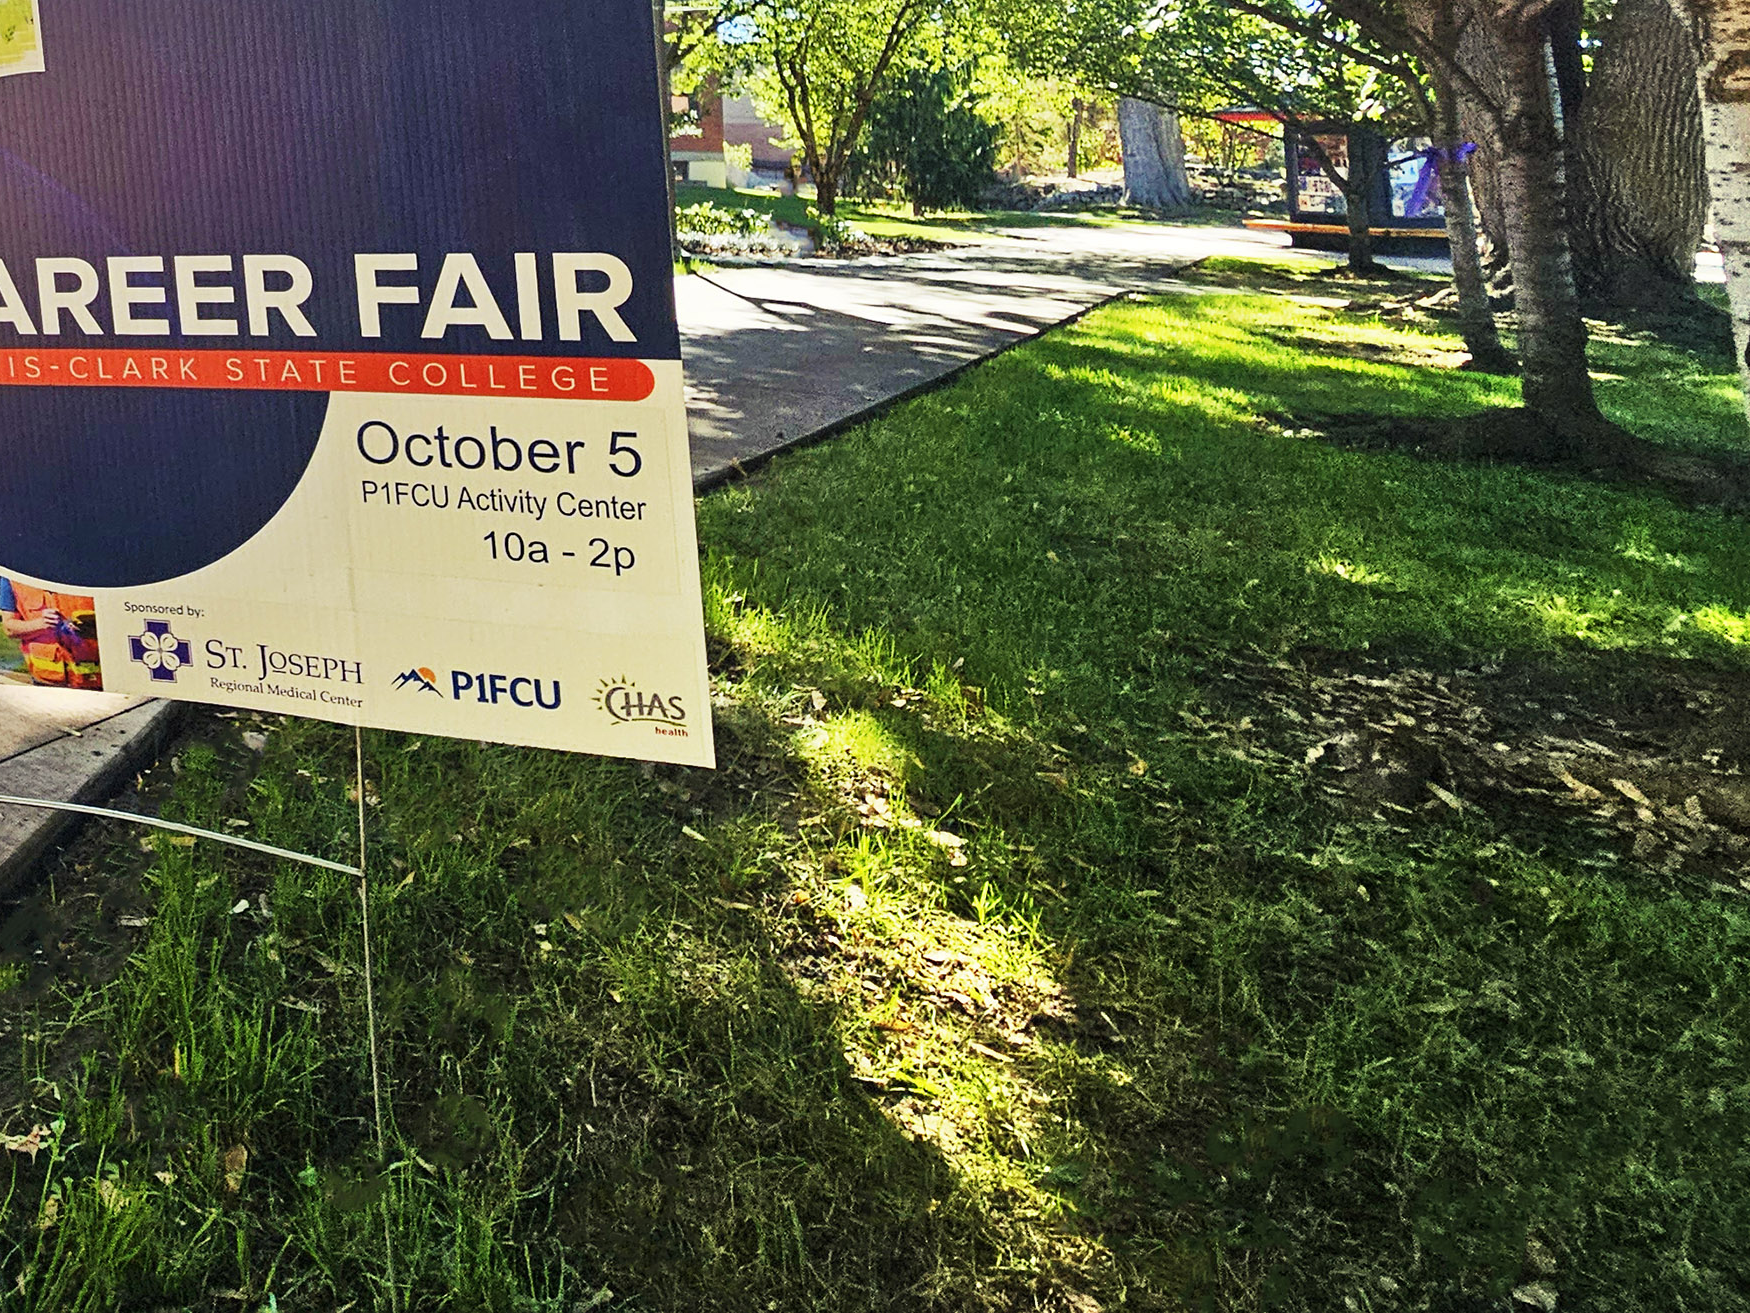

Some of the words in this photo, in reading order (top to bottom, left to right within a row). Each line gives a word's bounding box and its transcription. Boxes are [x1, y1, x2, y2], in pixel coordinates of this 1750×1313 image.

[354, 252, 638, 342] FAIR
[226, 358, 356, 385] STATE
[388, 361, 610, 392] COLLEGE
[356, 420, 585, 474] October
[608, 430, 642, 478] 5
[361, 480, 449, 508] P1FCU
[457, 486, 547, 521] Activity
[556, 491, 647, 521] Center
[483, 530, 549, 564] 10a
[588, 537, 636, 576] 2p
[123, 601, 184, 616] Sponsored
[187, 605, 205, 619] by:
[210, 676, 264, 694] Regional
[267, 682, 317, 702] Medical
[319, 690, 364, 709] Center
[450, 669, 562, 710] P1FCU
[605, 686, 686, 722] CHAS
[654, 725, 689, 738] health
